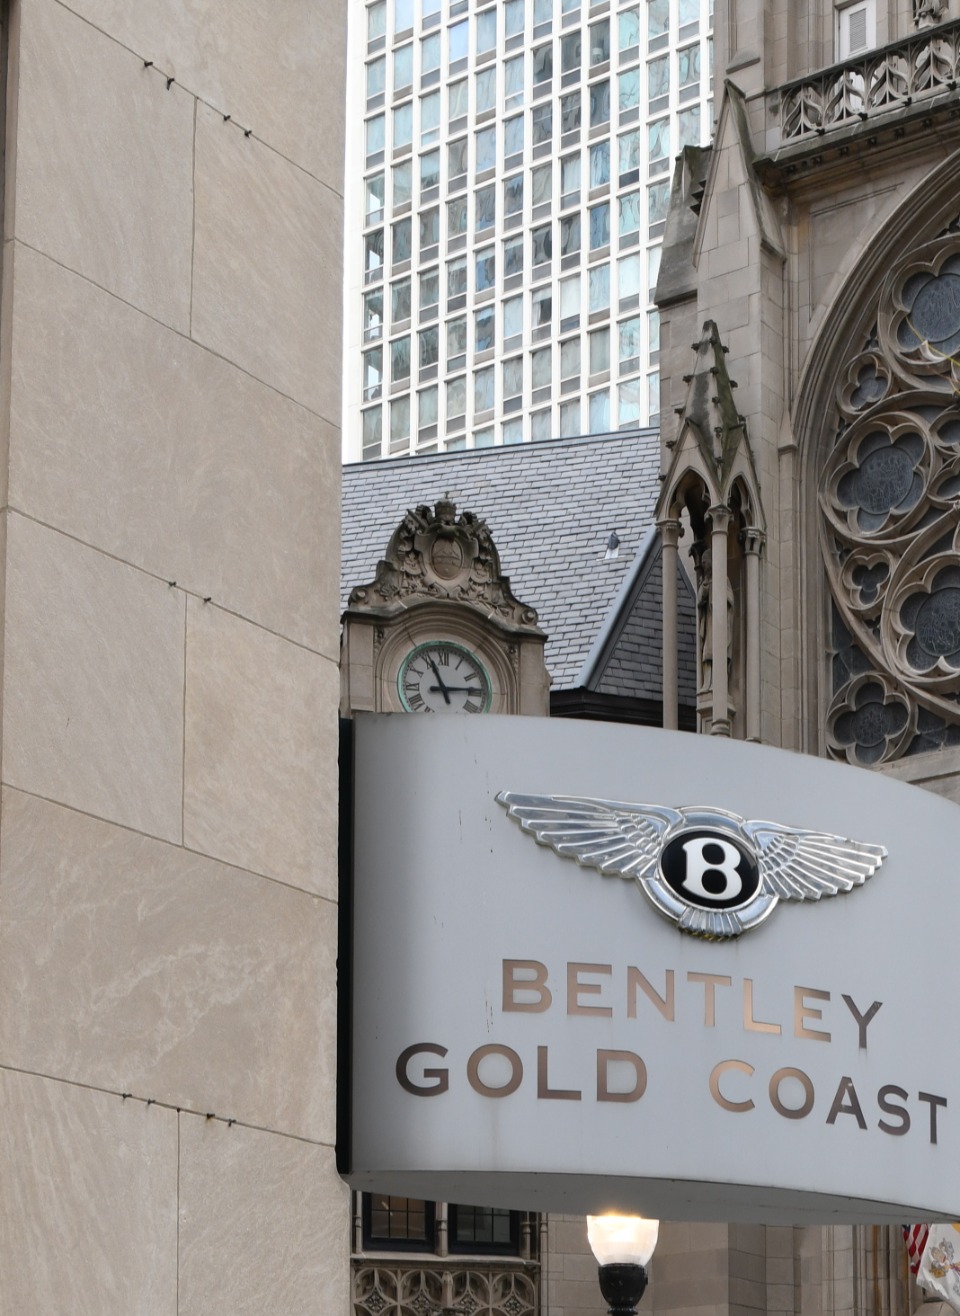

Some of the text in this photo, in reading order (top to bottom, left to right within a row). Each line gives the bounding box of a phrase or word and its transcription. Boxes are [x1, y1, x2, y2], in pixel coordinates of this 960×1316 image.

[438, 648, 449, 667] XII
[681, 837, 743, 900] B
[502, 958, 883, 1049] BENTLEY
[395, 1042, 948, 1145] GOLD COAST
